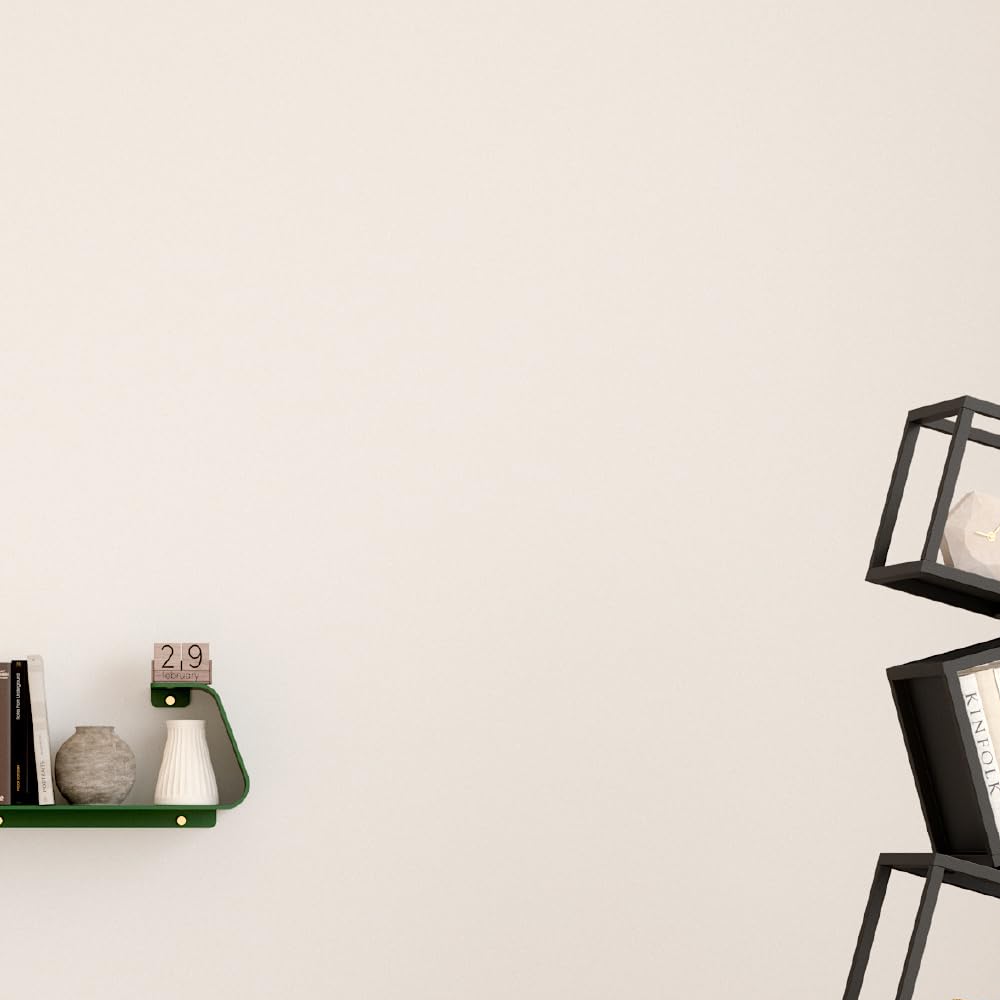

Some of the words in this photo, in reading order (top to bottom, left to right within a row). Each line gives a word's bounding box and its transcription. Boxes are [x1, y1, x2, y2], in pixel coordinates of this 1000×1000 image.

[161, 644, 174, 668] 2
[188, 644, 202, 668] 9
[964, 691, 1000, 795] KINFOLK
